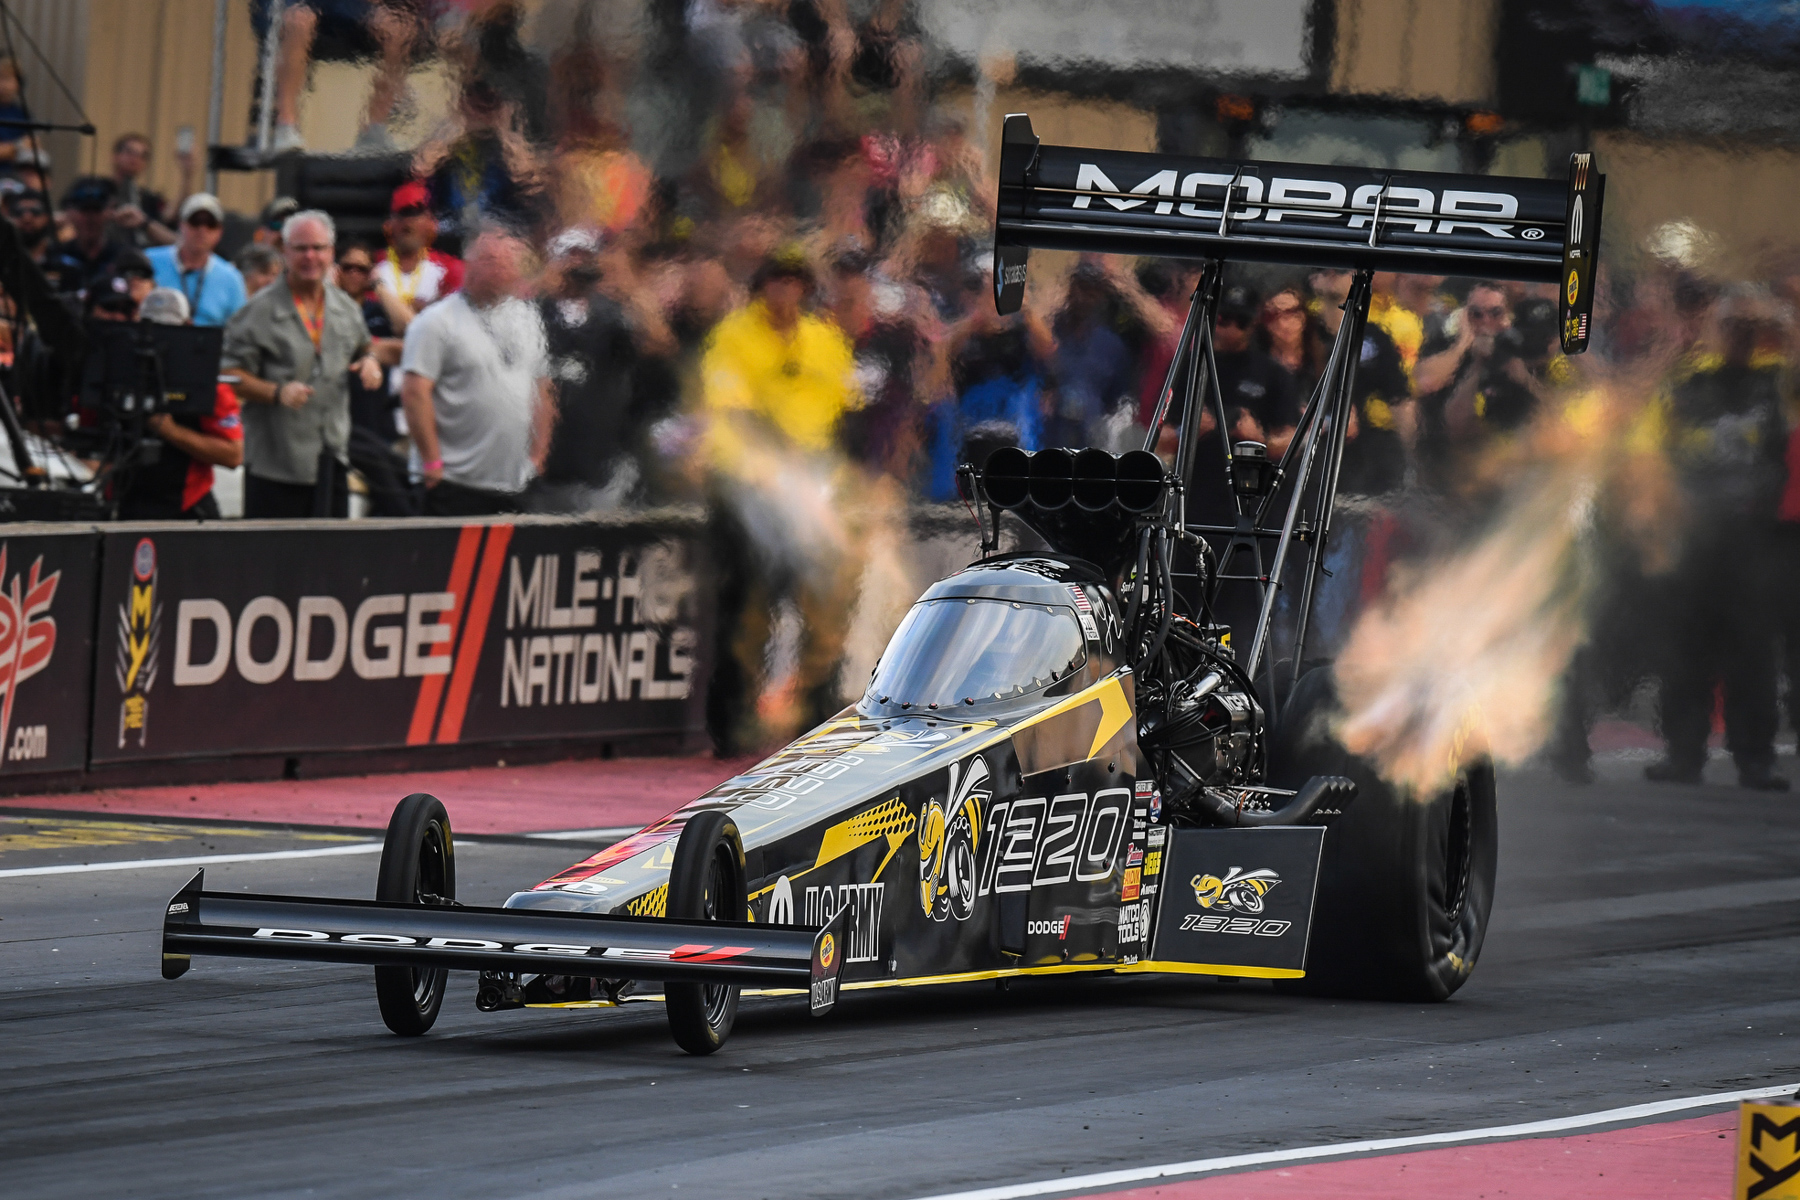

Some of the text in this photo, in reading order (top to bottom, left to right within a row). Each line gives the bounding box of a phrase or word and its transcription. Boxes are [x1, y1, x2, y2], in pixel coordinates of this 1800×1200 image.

[173, 591, 456, 686] DODGE
[500, 632, 692, 707] NATIONALS
[8, 725, 48, 761] .com
[978, 787, 1132, 897] 1320
[1144, 851, 1162, 876] JEGS
[1028, 920, 1065, 935] DODGE
[1118, 904, 1141, 925] MATCO
[1179, 914, 1292, 937] 1320
[253, 926, 679, 958] DODGE
[1118, 921, 1140, 944] TOOLS
